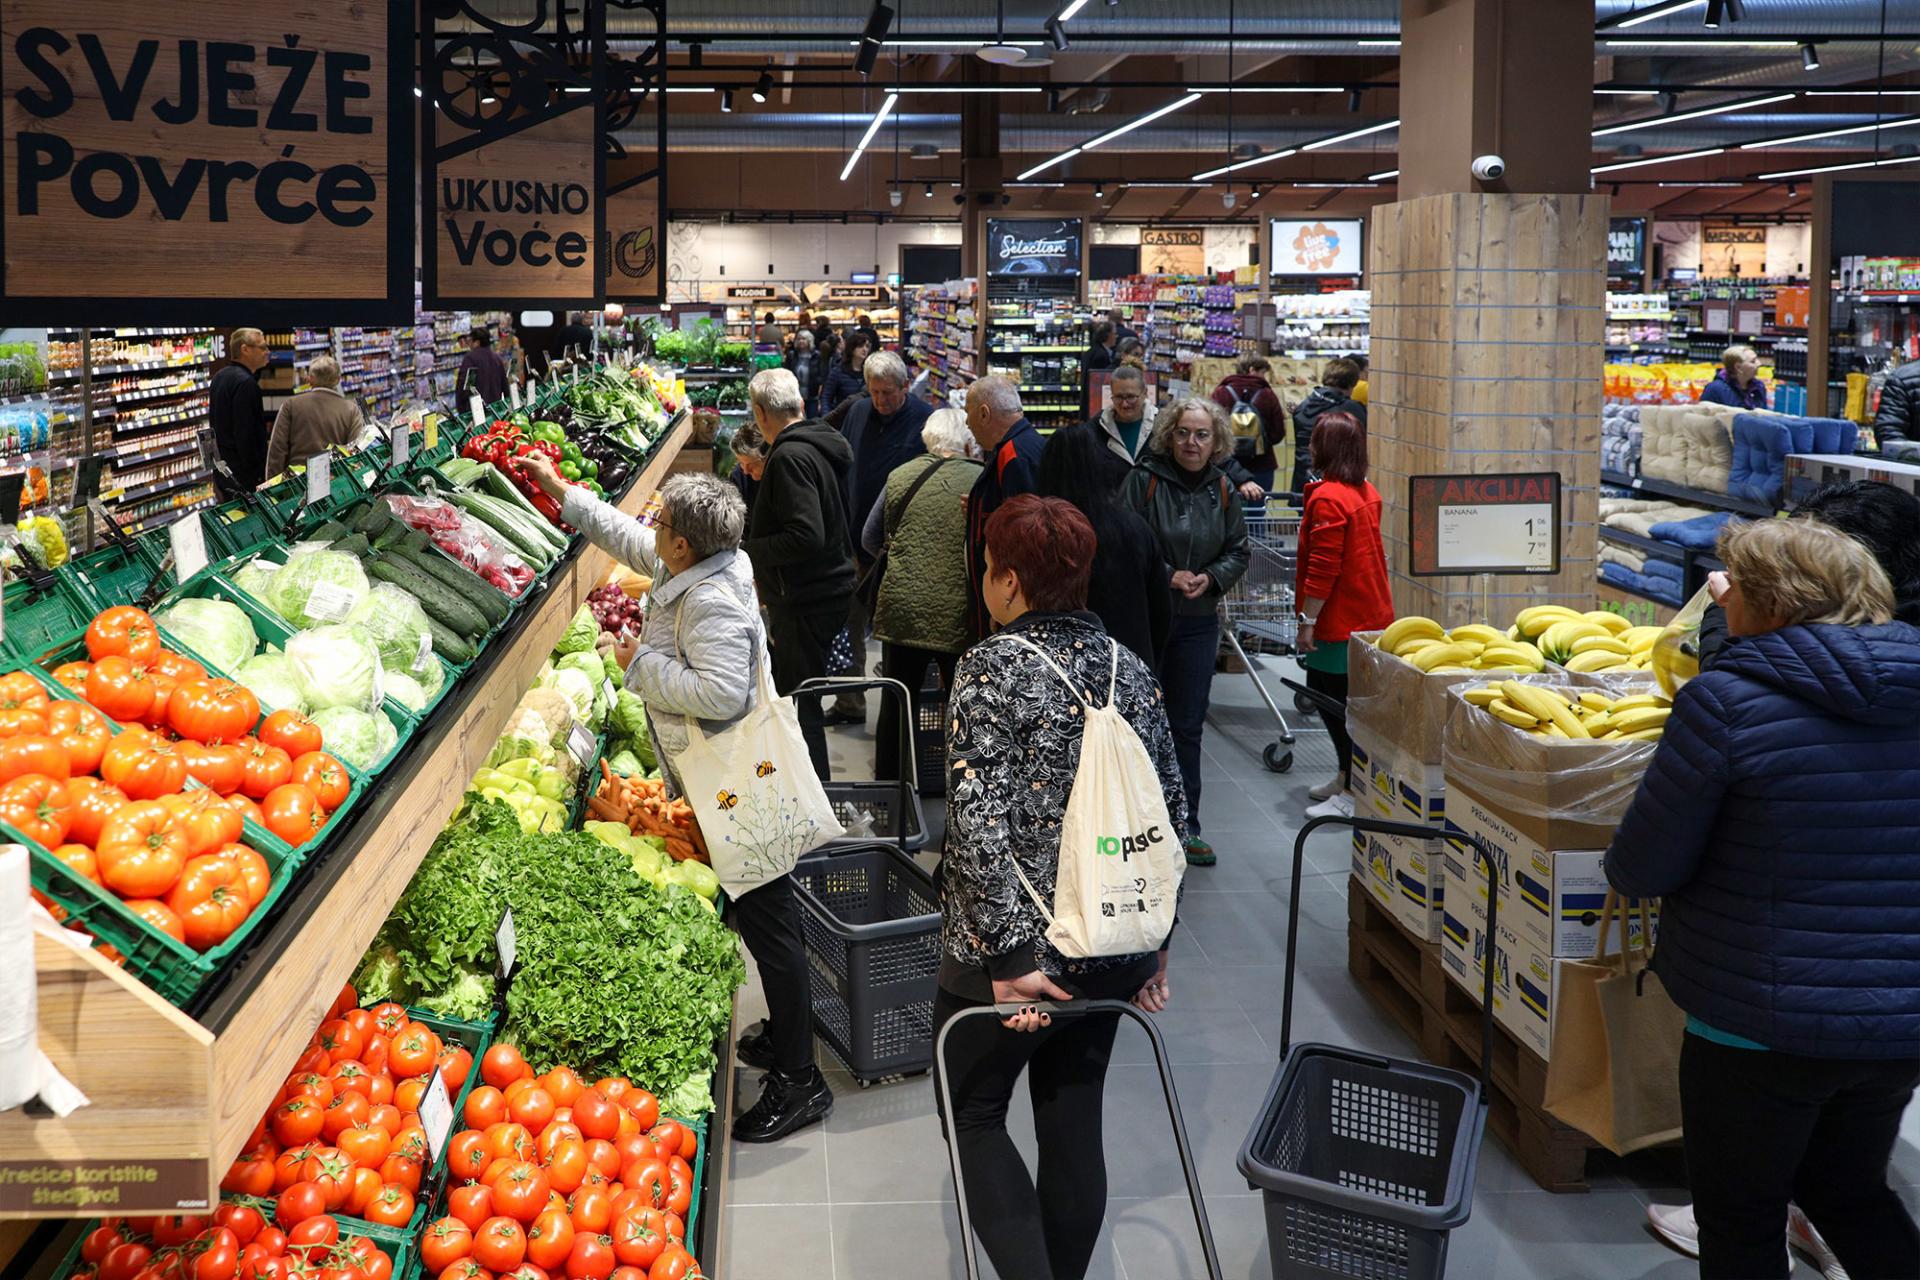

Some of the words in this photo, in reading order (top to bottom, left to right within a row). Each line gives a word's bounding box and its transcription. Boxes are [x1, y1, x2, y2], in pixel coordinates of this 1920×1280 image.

[14, 27, 374, 133] SVJEŽE
[16, 131, 377, 226] Povrće
[442, 178, 590, 215] UKUSNO
[445, 220, 588, 267] Voće
[999, 235, 1067, 258] Selection
[1144, 232, 1200, 244] GASTRO
[1707, 231, 1762, 241] MESNICA
[1441, 478, 1551, 502] AKCIJA!
[1525, 518, 1533, 537] 1
[1528, 542, 1536, 554] 7
[1471, 805, 1500, 832] PREMIUM
[1501, 826, 1518, 845] PACK
[1501, 927, 1518, 945] PACK
[75, 1166, 157, 1183] koristite
